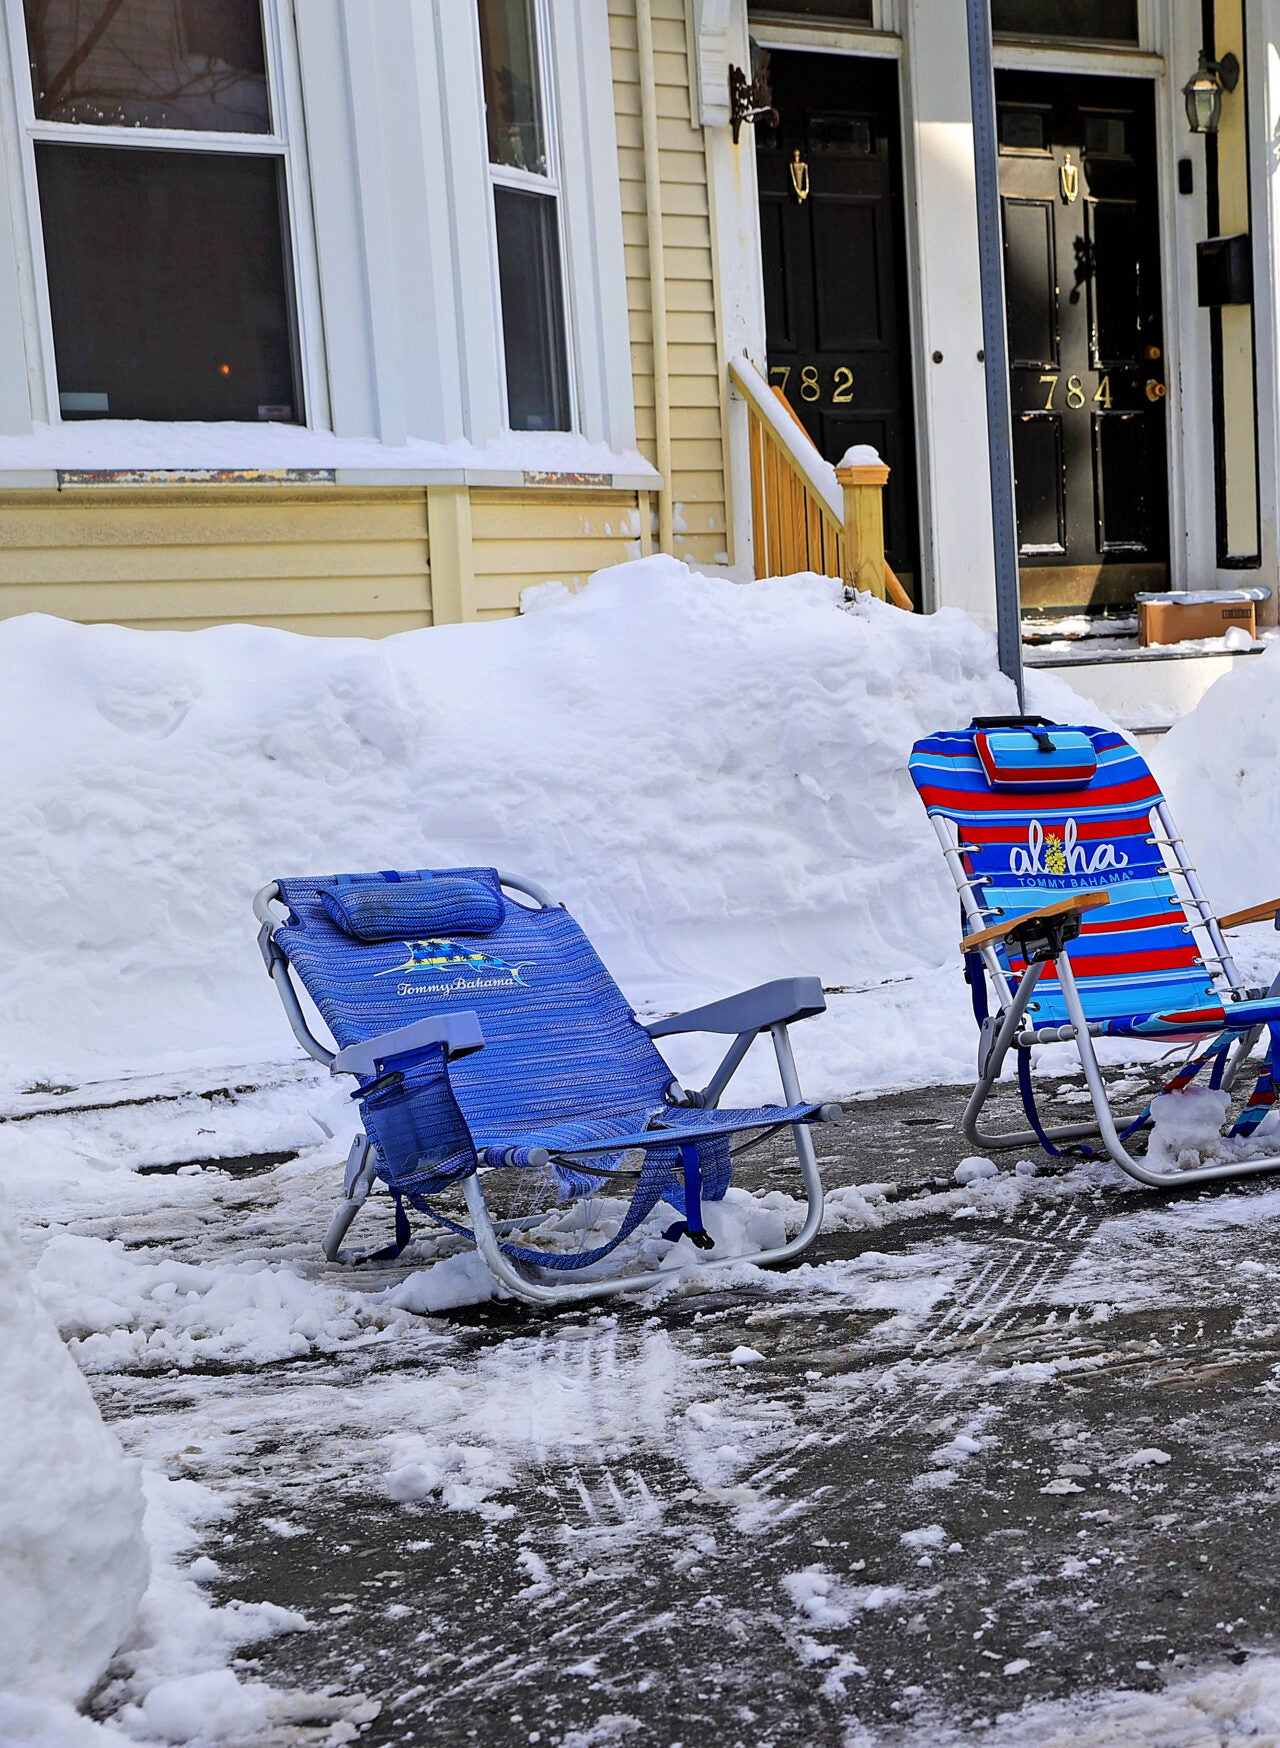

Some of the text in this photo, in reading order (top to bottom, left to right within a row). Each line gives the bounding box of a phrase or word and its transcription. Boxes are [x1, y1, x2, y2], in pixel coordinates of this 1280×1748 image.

[769, 365, 854, 403] 782
[1039, 374, 1113, 410] 784
[1017, 877, 1067, 889] TOMMY
